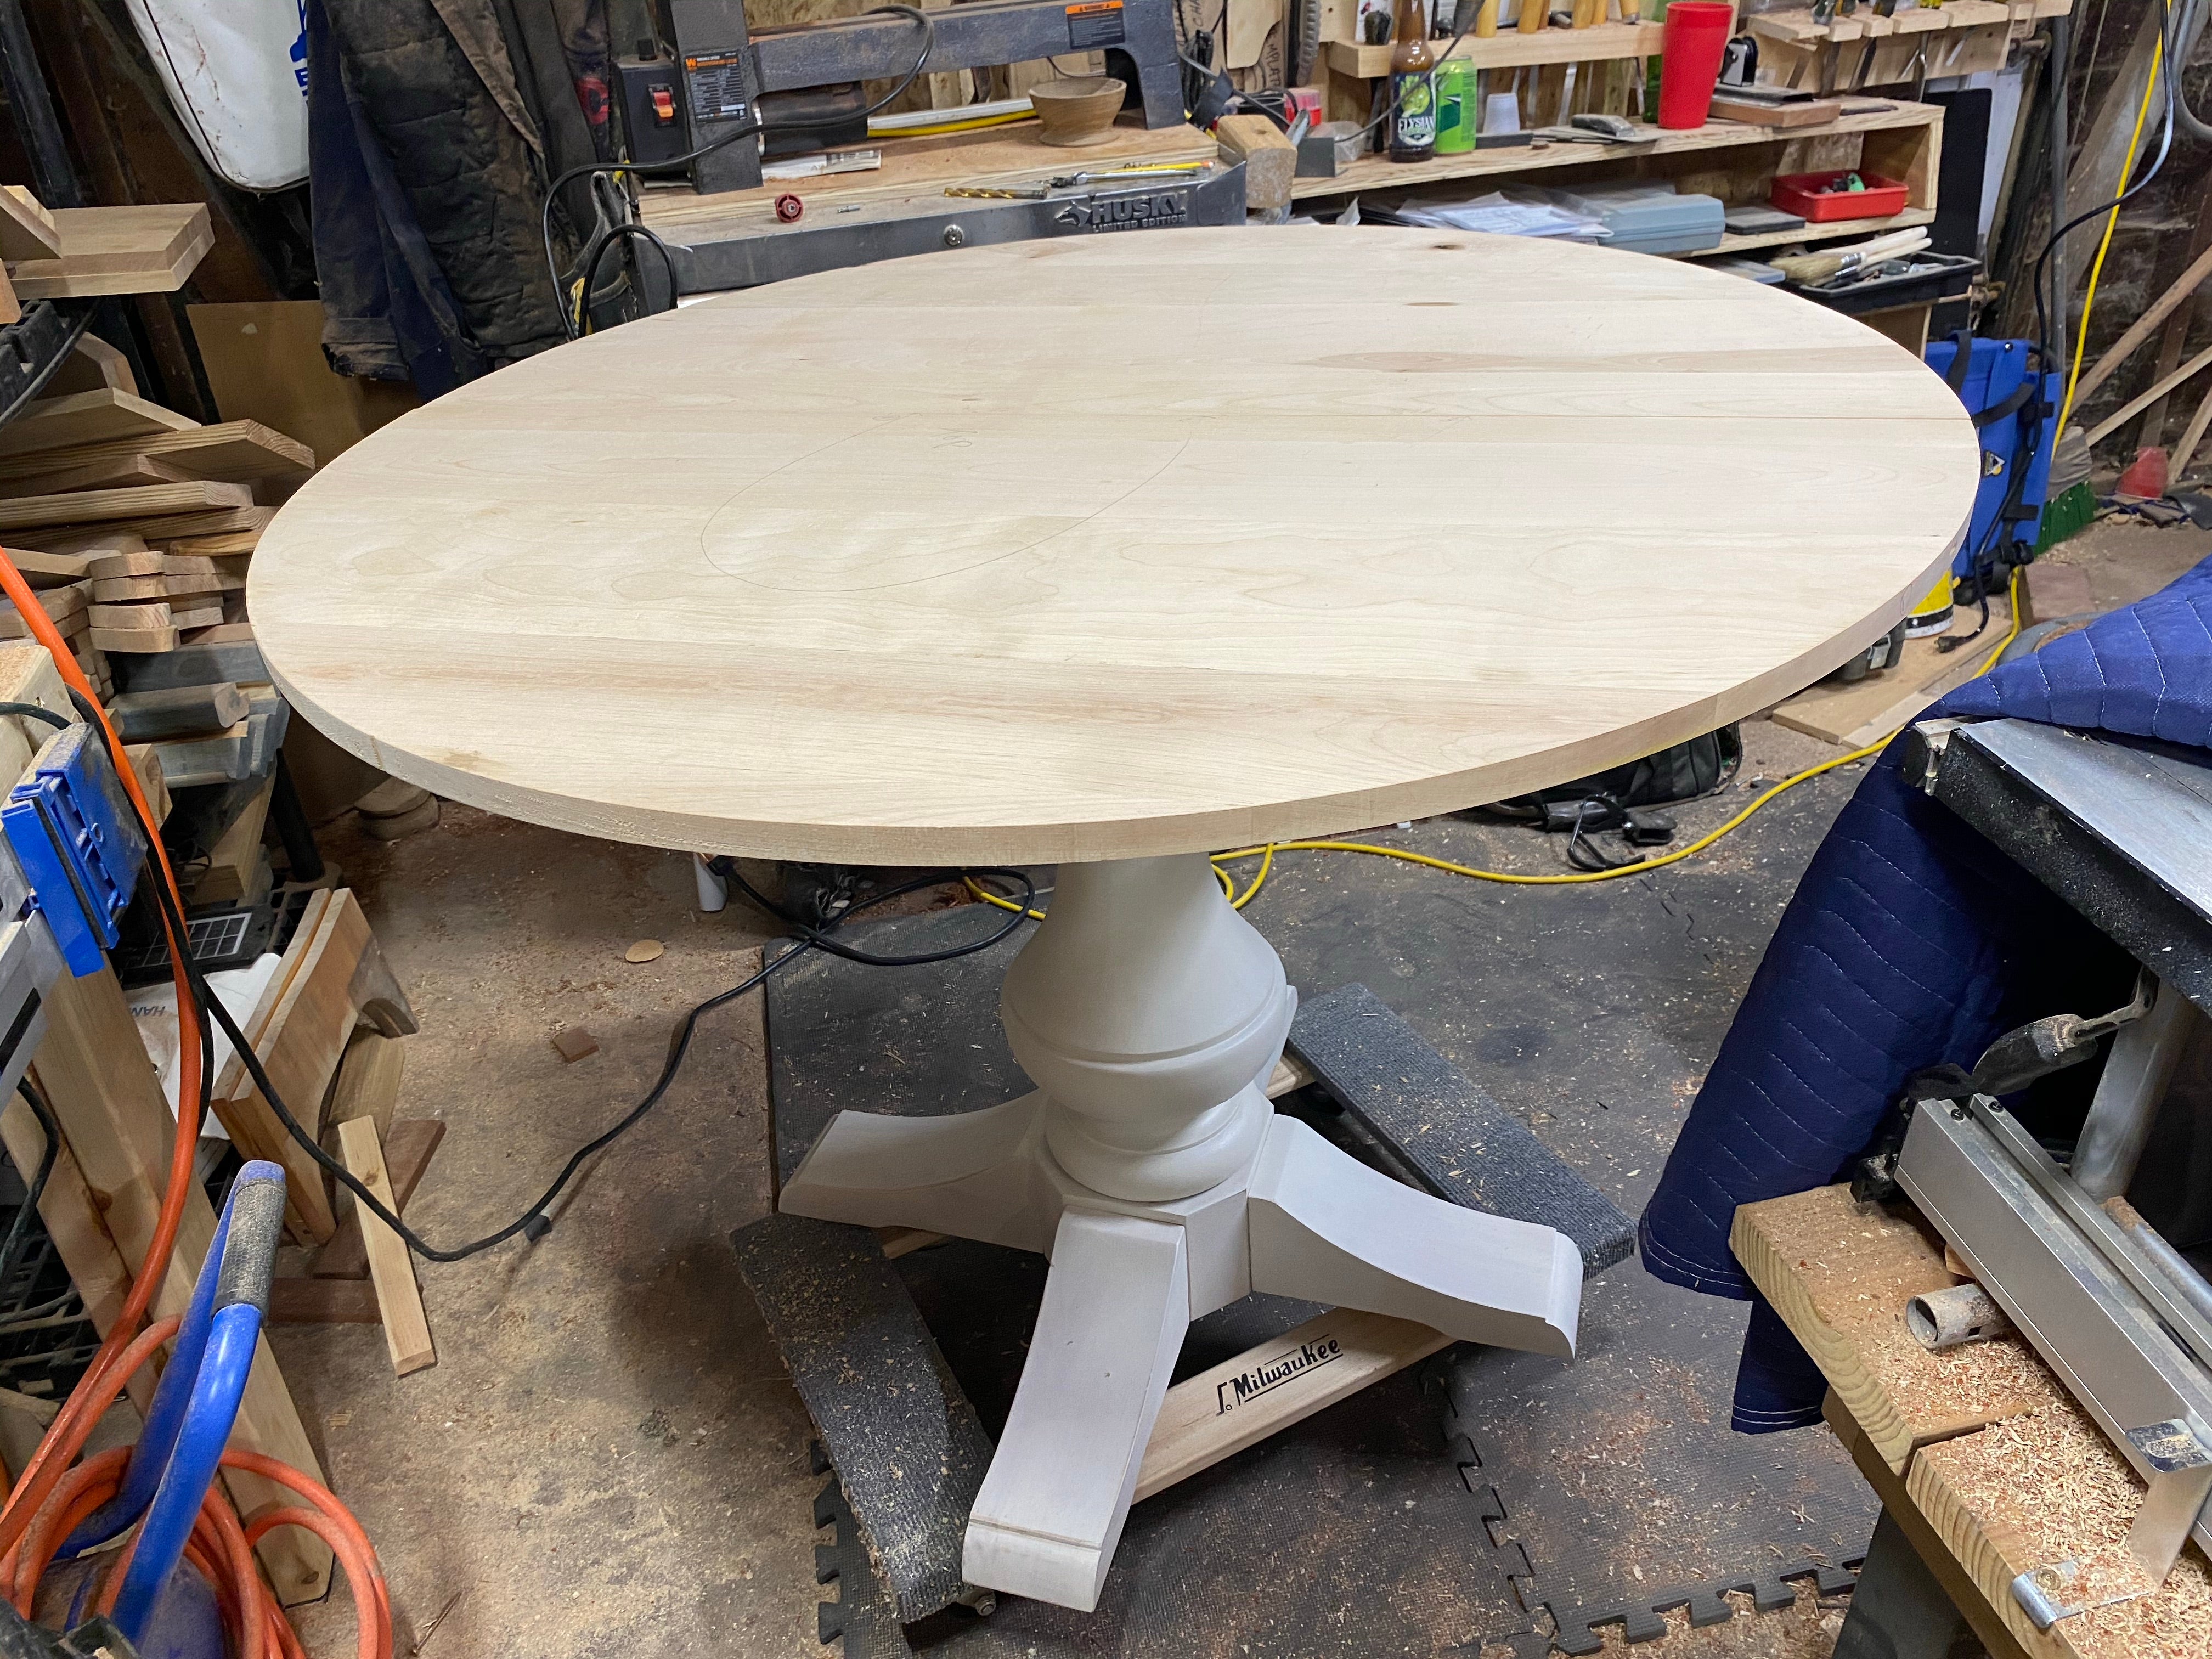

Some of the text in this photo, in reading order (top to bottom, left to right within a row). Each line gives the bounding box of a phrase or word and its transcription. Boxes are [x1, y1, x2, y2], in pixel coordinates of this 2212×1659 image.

[1091, 190, 1188, 224] HUSKY
[1092, 213, 1187, 233] LIMITED EDITION
